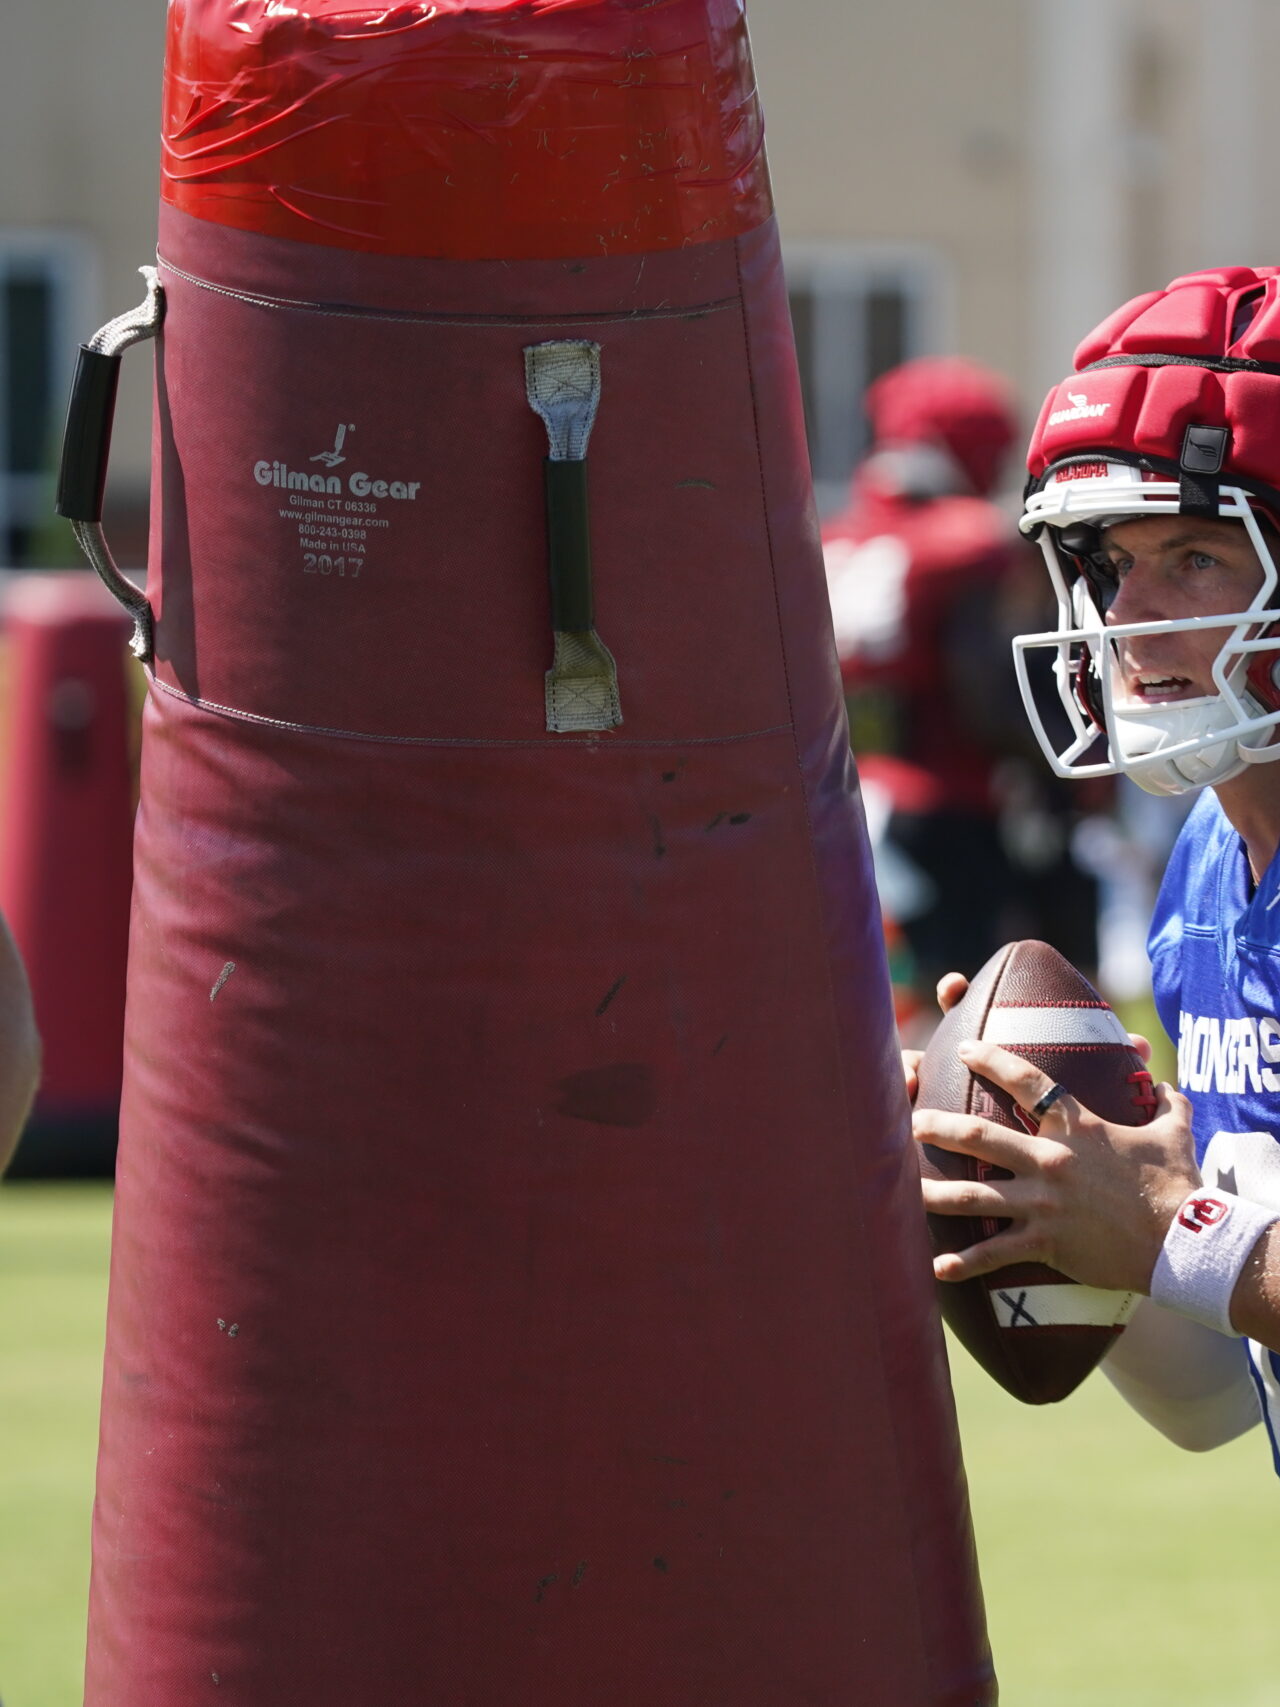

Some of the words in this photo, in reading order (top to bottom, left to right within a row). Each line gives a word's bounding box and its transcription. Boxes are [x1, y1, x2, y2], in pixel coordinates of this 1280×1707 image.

[253, 460, 342, 495] Gilman
[348, 471, 421, 500] Gear
[289, 494, 325, 509] Gilman
[327, 499, 342, 511] CT
[344, 501, 377, 513] 06336
[278, 508, 389, 528] www.gilmangear.com
[298, 524, 367, 540] 800-243-0398
[299, 538, 327, 551] Made
[329, 542, 340, 551] in
[342, 543, 366, 553] USA
[303, 552, 364, 578] 2017
